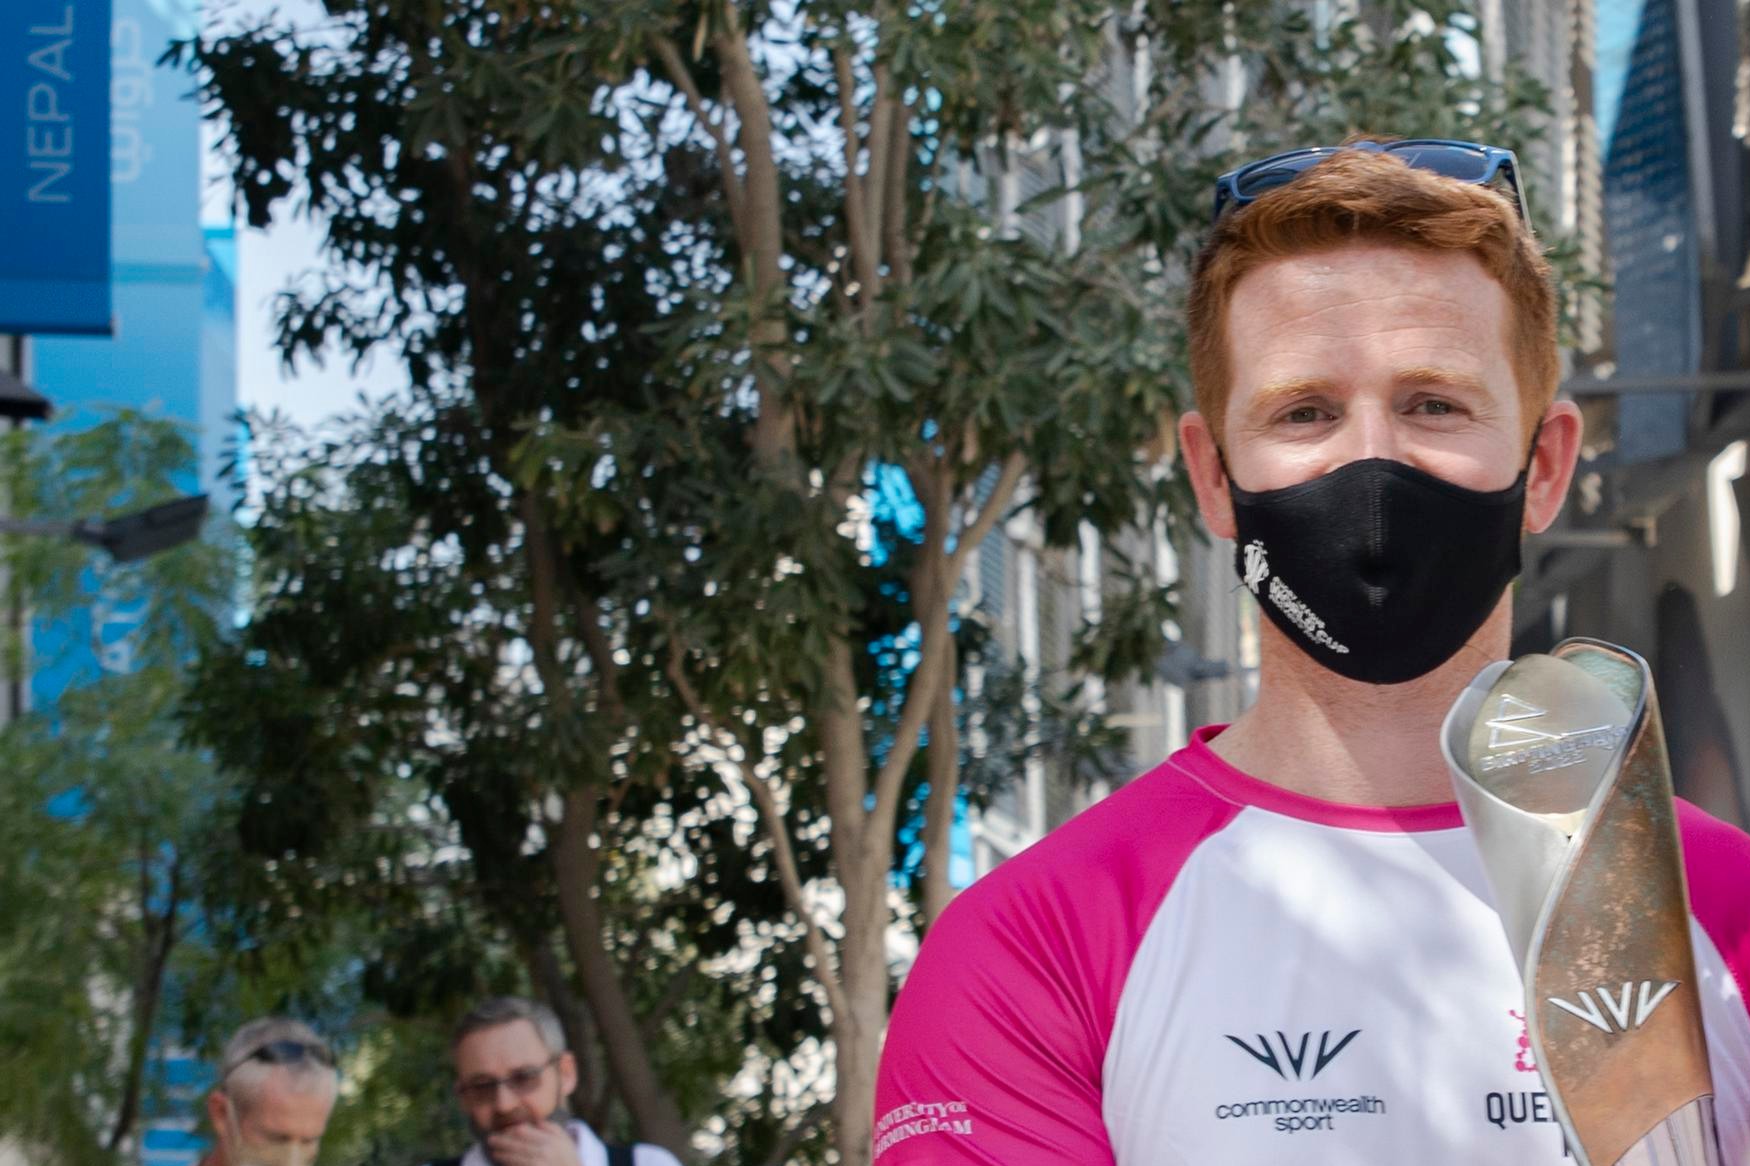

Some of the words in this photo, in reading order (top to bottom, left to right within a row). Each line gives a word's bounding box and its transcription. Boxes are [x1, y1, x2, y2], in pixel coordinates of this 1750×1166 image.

[27, 4, 75, 203] NEPAL
[1215, 1096, 1387, 1119] commonwealth
[1486, 1092, 1557, 1130] QUE
[1274, 1113, 1335, 1134] sport
